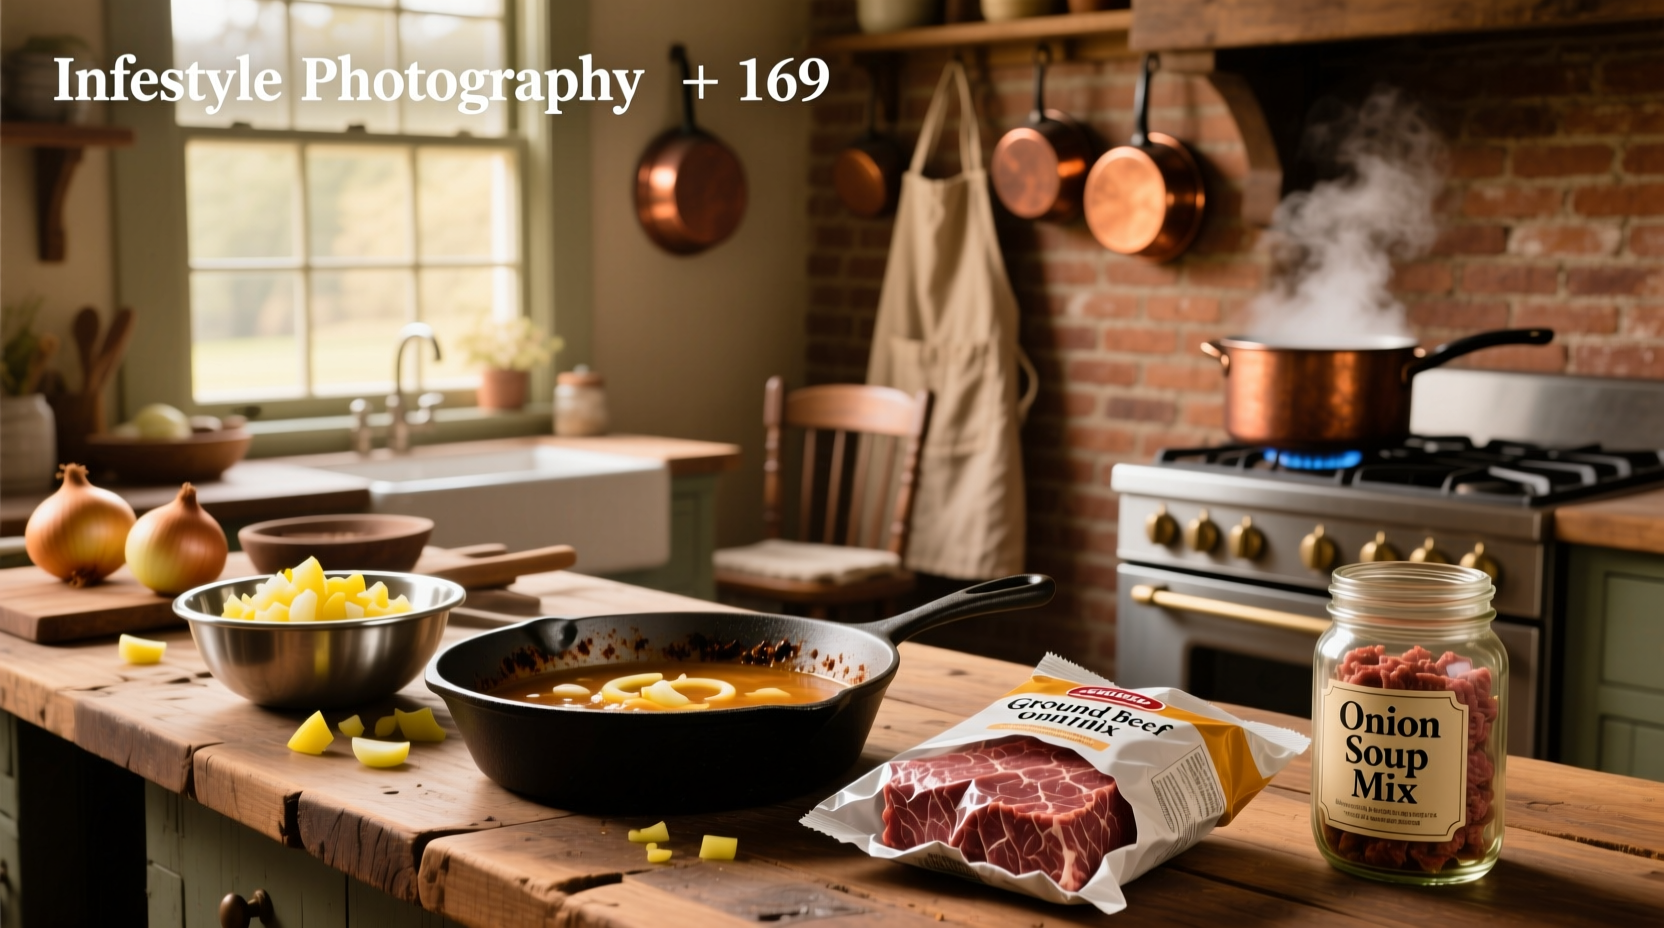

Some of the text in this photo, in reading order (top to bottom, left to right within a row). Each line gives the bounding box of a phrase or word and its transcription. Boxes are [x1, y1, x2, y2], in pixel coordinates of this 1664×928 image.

[1007, 698, 1112, 719] Ground
[1111, 710, 1174, 736] Beef
[1339, 700, 1441, 738] Onion
[1345, 734, 1429, 779] Soup
[1351, 768, 1418, 805] Mix
